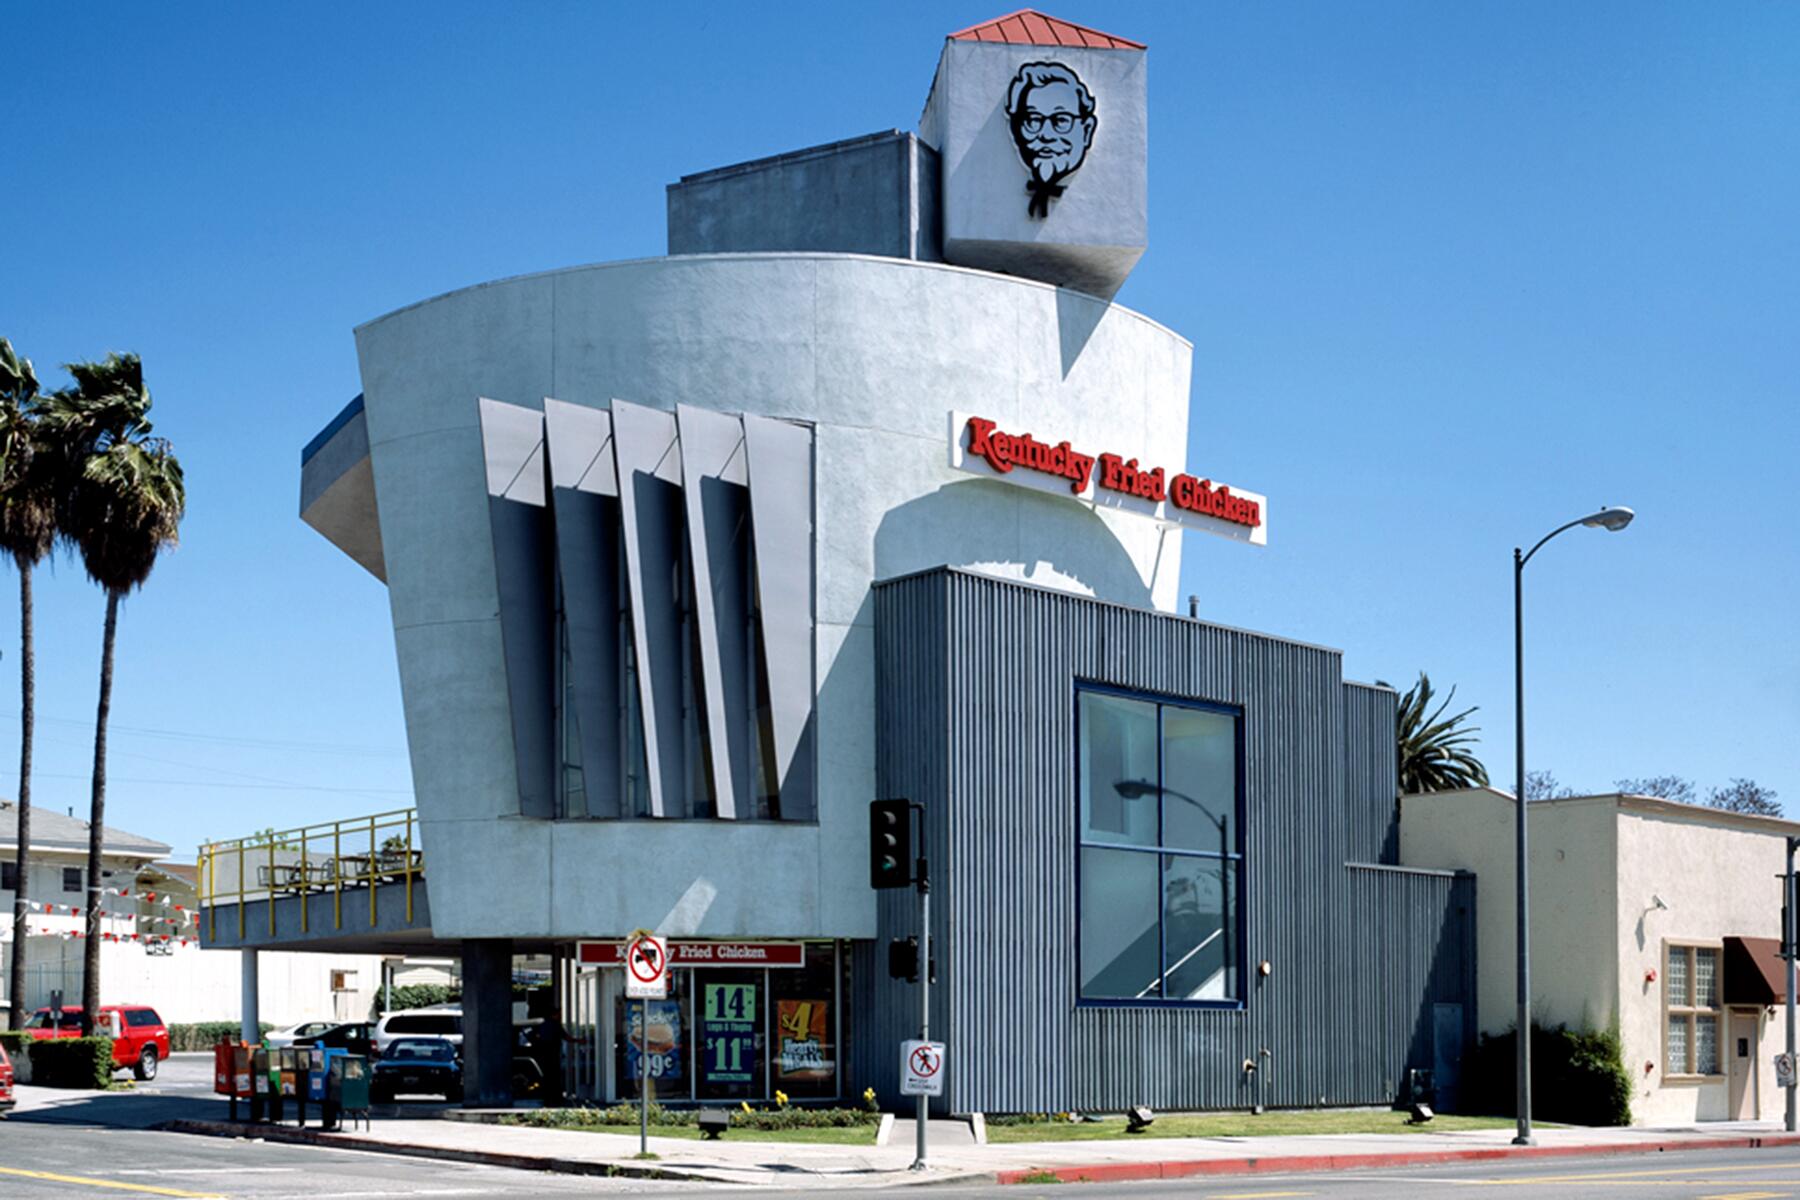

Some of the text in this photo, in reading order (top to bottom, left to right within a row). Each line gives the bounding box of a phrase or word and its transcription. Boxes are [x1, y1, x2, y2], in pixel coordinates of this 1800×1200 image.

[967, 416, 1260, 528] Kentucky Fried Chicken
[678, 945, 713, 959] Fried
[717, 945, 767, 959] Chicken
[715, 987, 744, 1018] 14
[781, 1002, 811, 1041] $4
